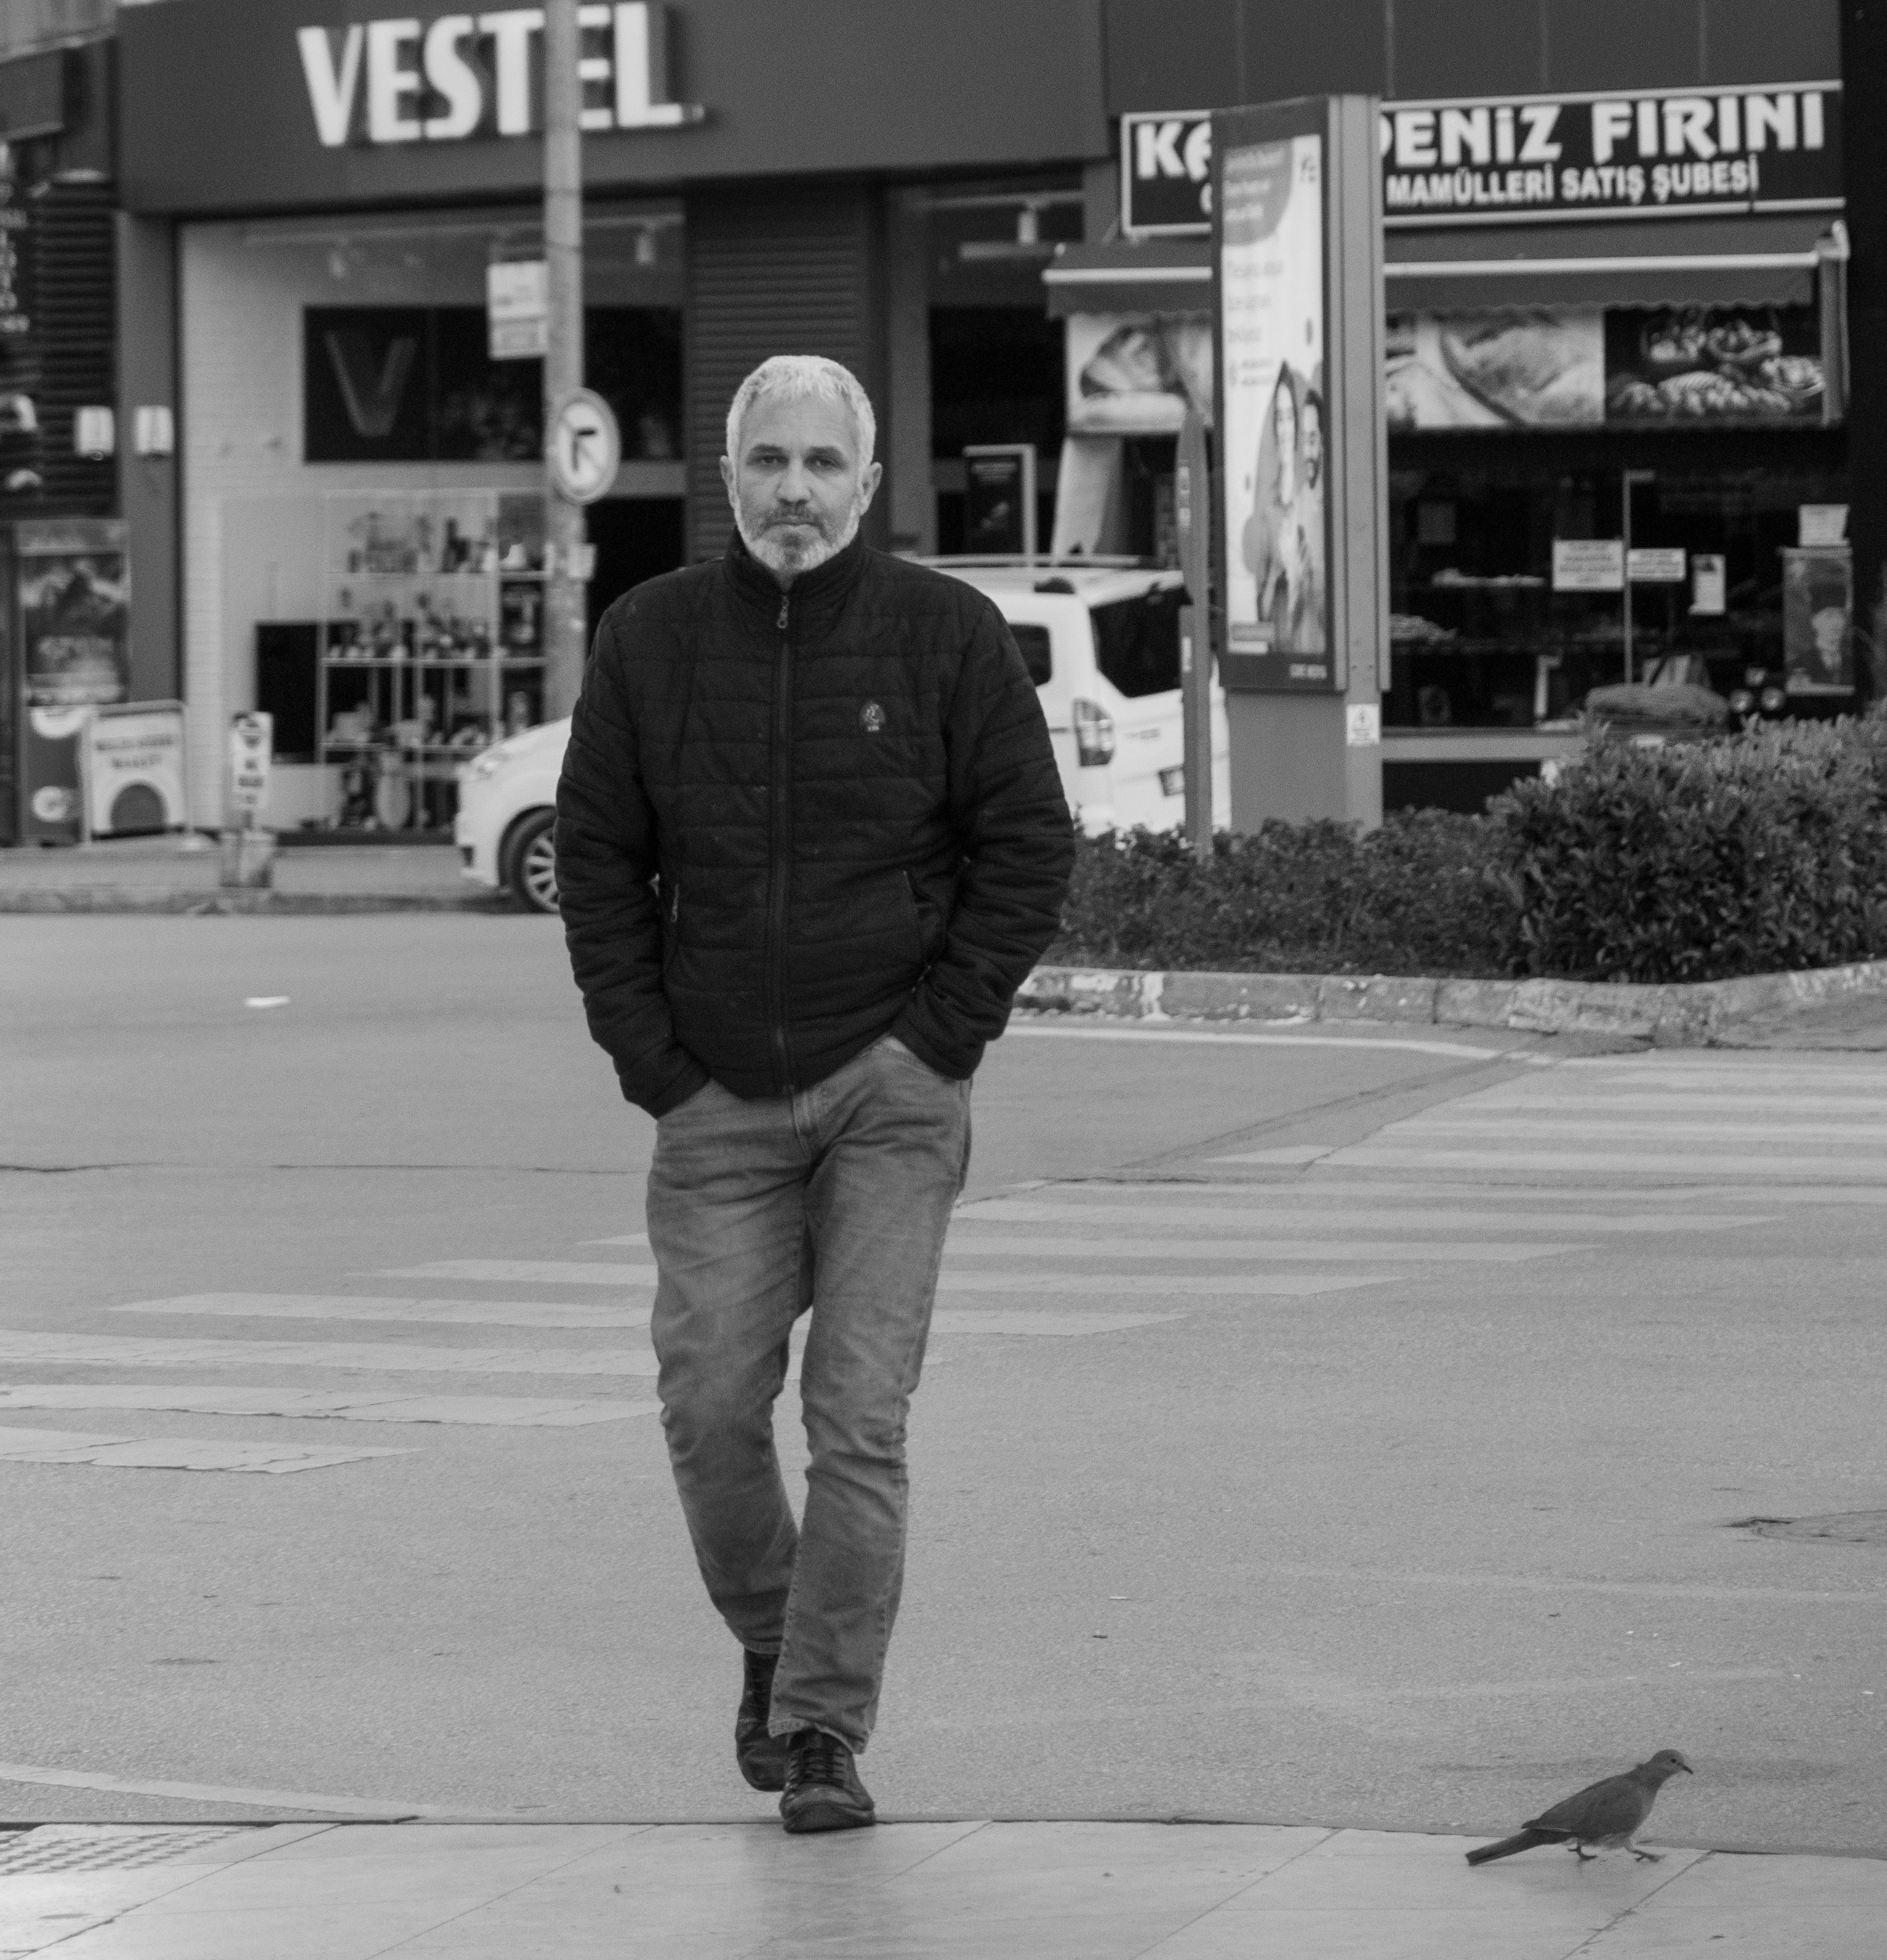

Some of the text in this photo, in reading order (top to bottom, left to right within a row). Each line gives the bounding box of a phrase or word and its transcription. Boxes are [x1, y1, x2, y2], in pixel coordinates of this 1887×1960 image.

[296, 2, 683, 146] VESTEL
[1592, 93, 1825, 164] FIRINI
[1386, 154, 1760, 207] MAMÜLLERİ SATIŞ ŞUBESİ
